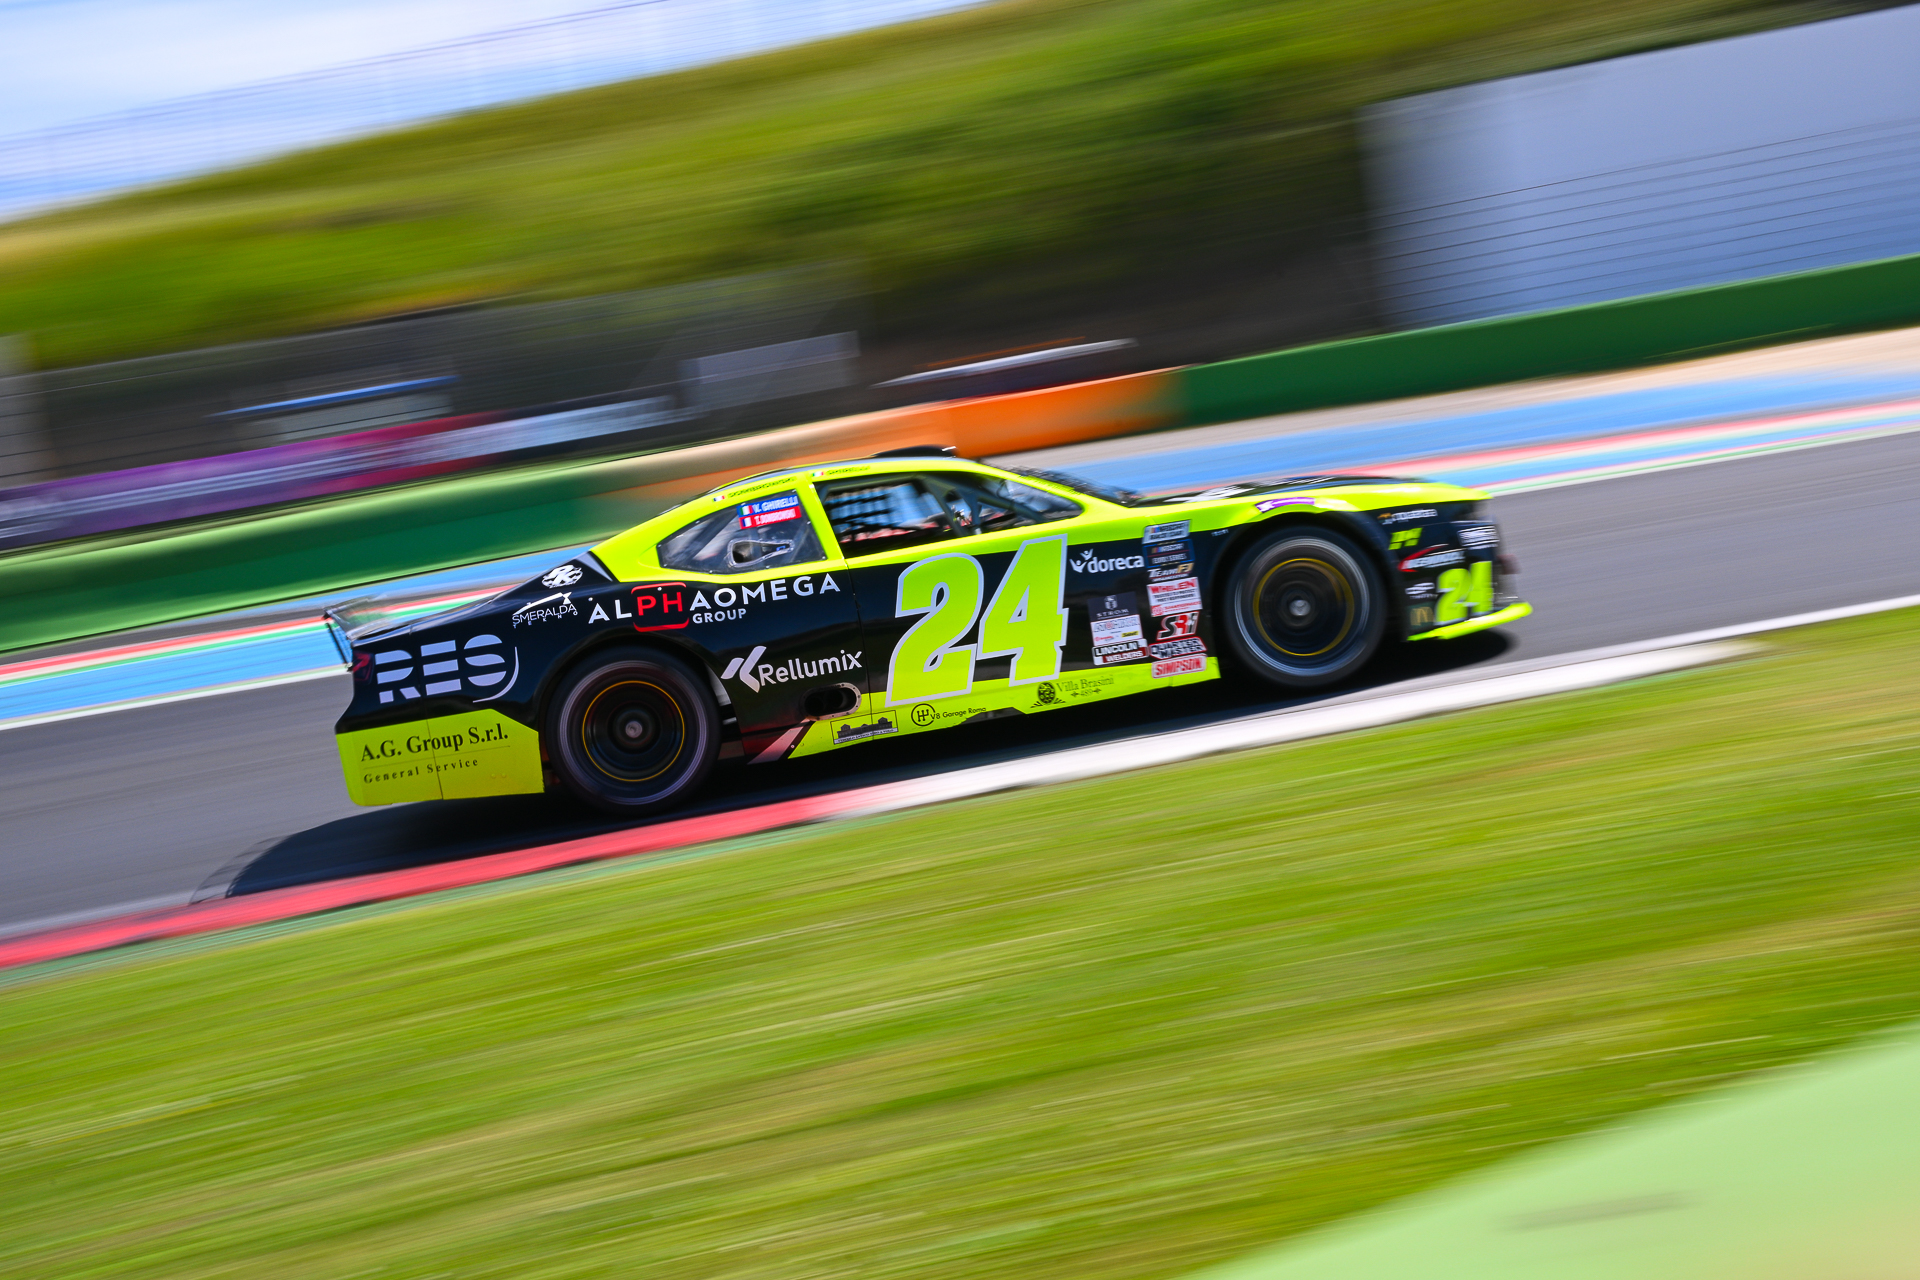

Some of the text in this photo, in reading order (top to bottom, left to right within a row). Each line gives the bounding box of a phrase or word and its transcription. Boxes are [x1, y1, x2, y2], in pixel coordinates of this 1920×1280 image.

[1087, 554, 1145, 574] doreca
[588, 573, 840, 624] ALPHAOMEGA
[1435, 561, 1493, 626] 24
[512, 603, 577, 624] SMERALDA
[692, 608, 747, 624] GROUP
[884, 533, 1069, 708] 24
[1095, 642, 1138, 656] LINCOLN
[375, 634, 507, 704] RES
[758, 649, 862, 686] Rellumix
[1156, 657, 1202, 676] SIMPSON
[1056, 681, 1079, 692] Villa
[930, 706, 987, 720] V8 Garage Roma
[361, 723, 508, 762] A.G. Group S.r.l.
[363, 758, 478, 784] General Service
